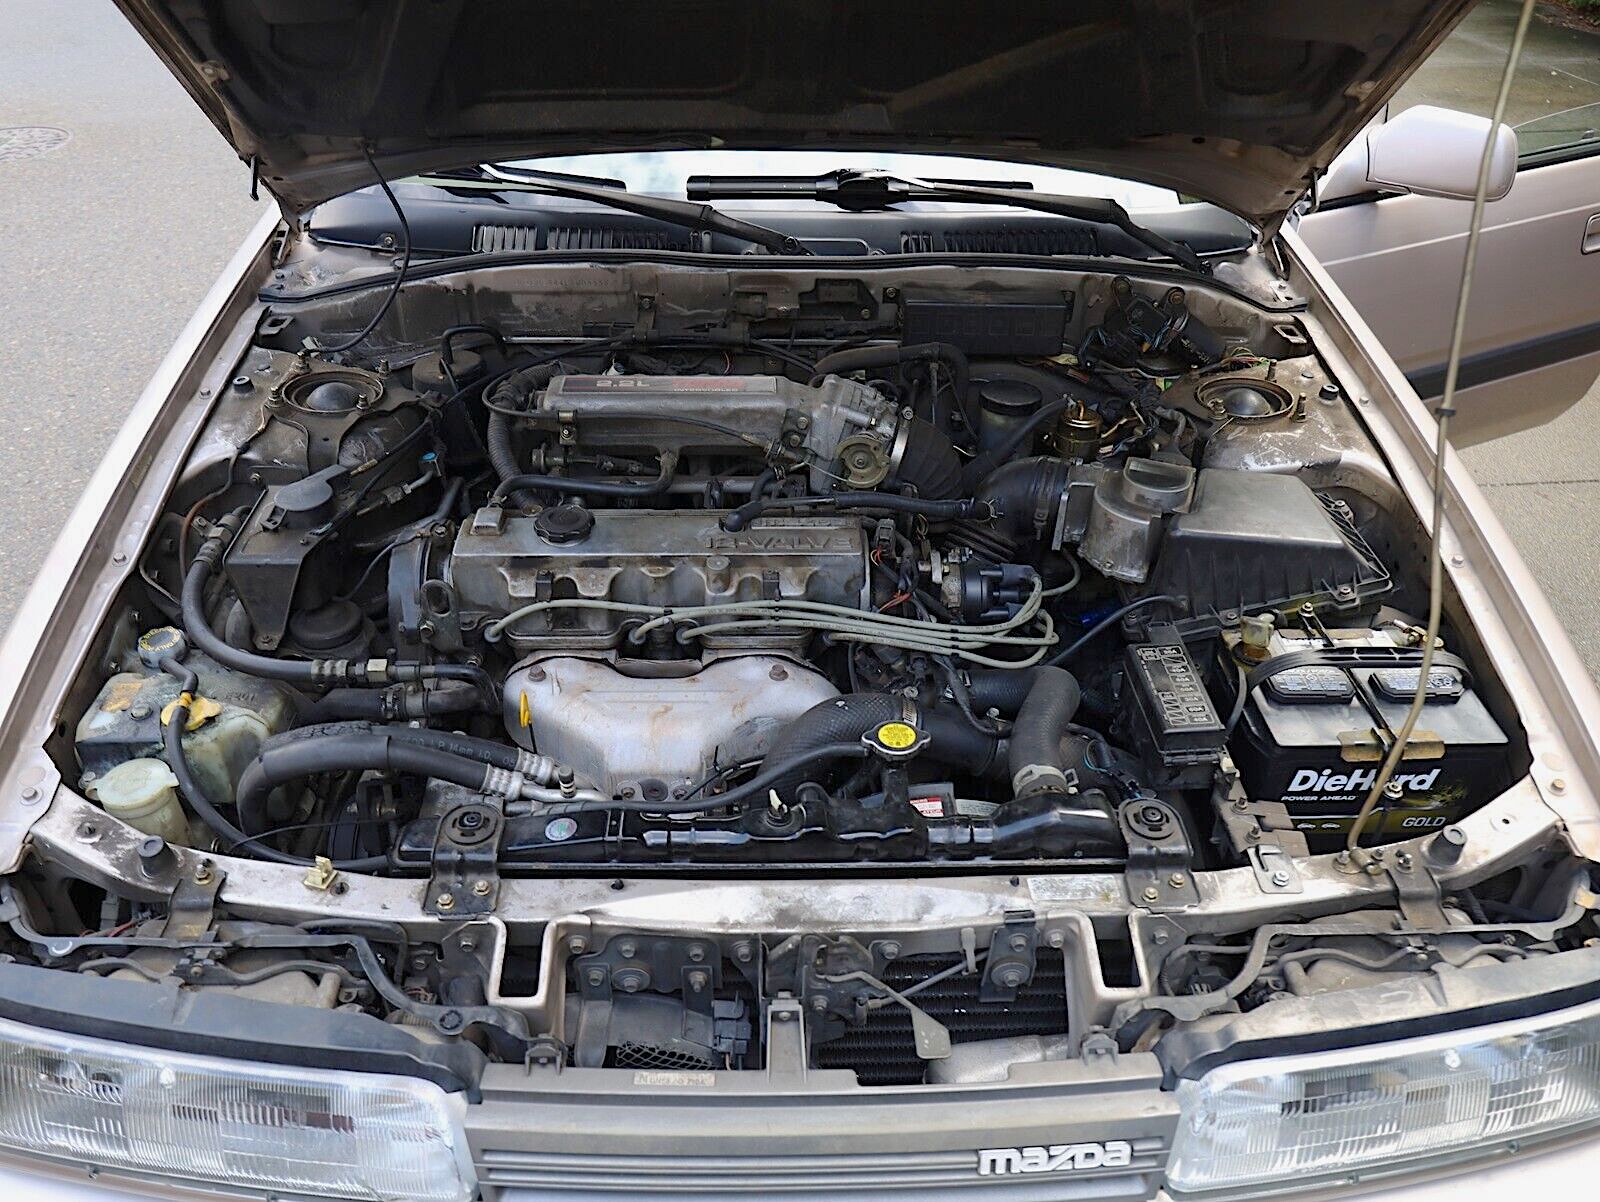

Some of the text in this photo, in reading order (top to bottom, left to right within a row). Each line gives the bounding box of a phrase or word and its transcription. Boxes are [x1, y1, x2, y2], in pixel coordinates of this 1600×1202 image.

[596, 378, 650, 388] 2.2L
[1287, 768, 1442, 792] DieHrd
[1402, 817, 1448, 827] GOLD
[977, 1140, 1132, 1176] mazda
